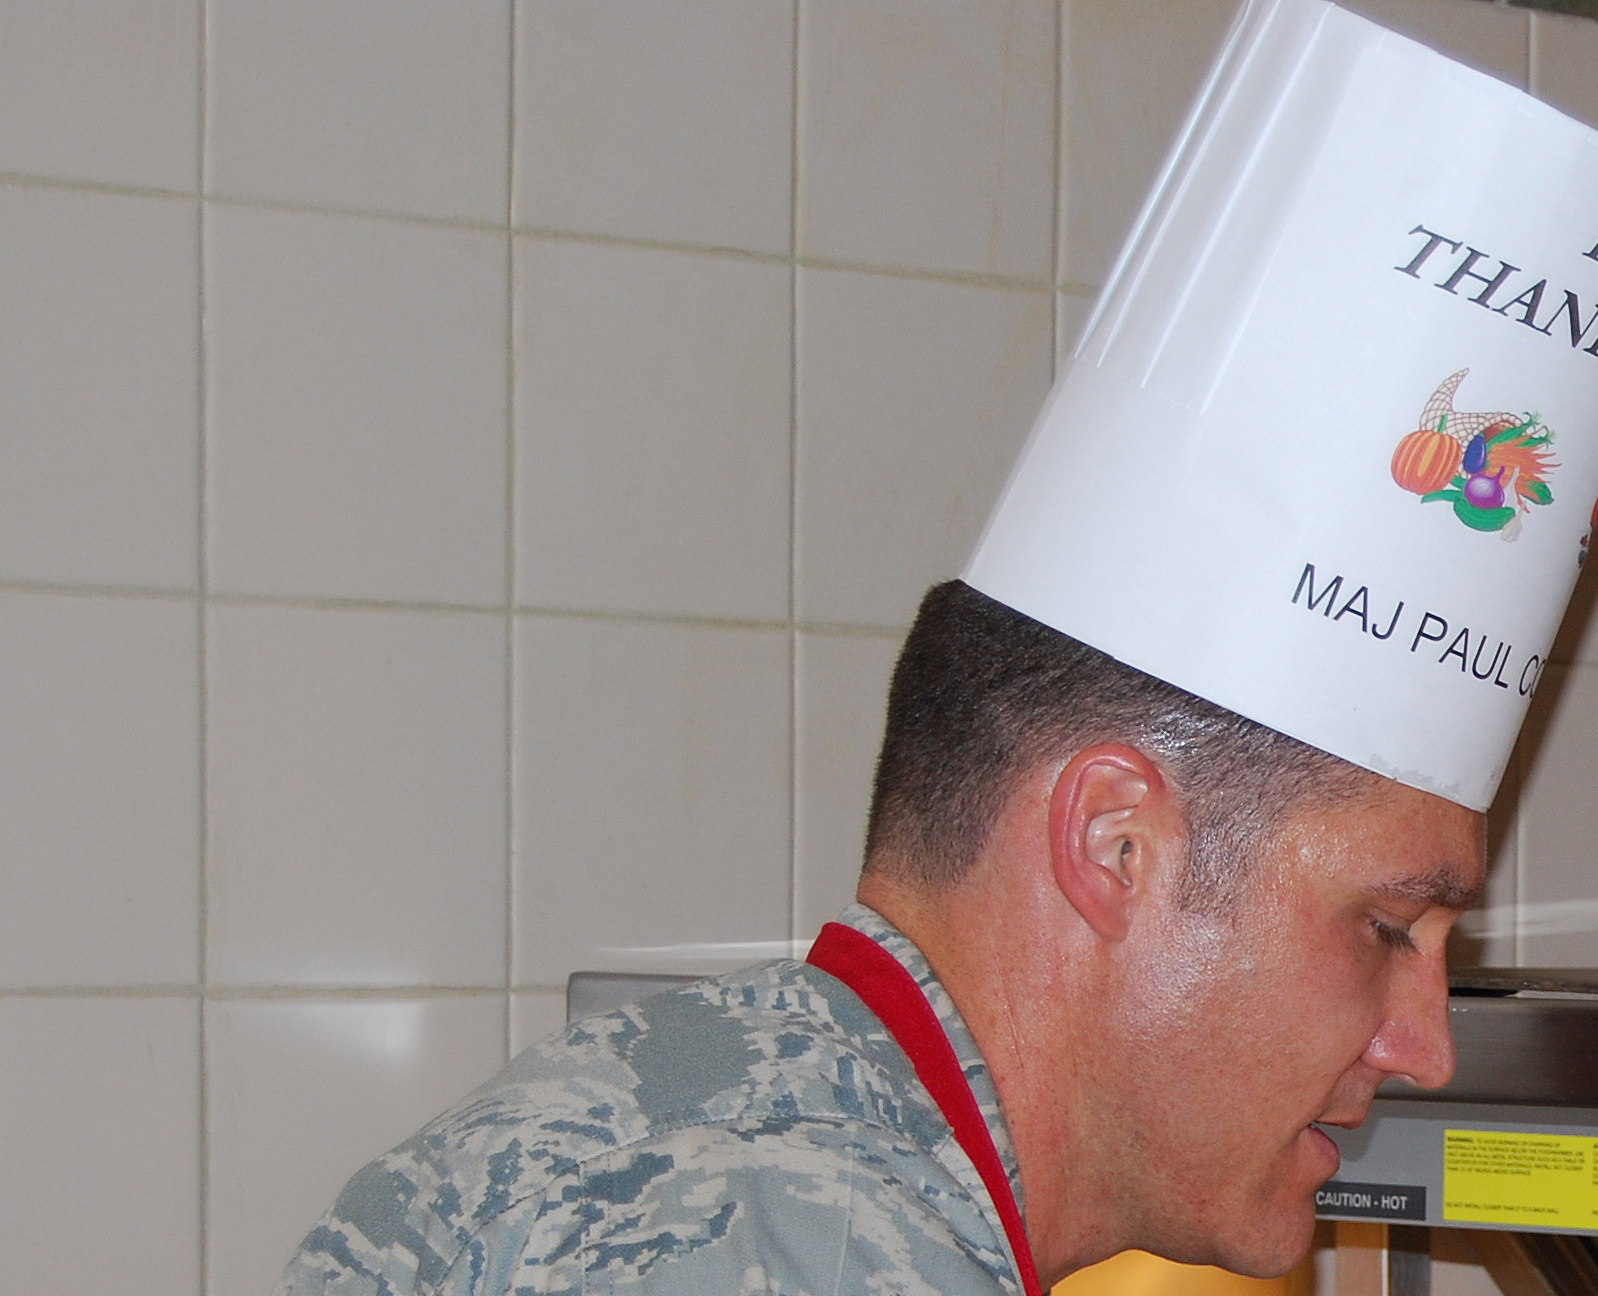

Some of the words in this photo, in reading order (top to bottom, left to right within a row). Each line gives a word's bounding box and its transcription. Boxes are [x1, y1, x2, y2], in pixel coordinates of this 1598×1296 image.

[1291, 562, 1404, 641] MAJ
[1410, 611, 1512, 689] PAUL
[1315, 1190, 1371, 1208] CAUTION
[1381, 1195, 1408, 1210] HOT
